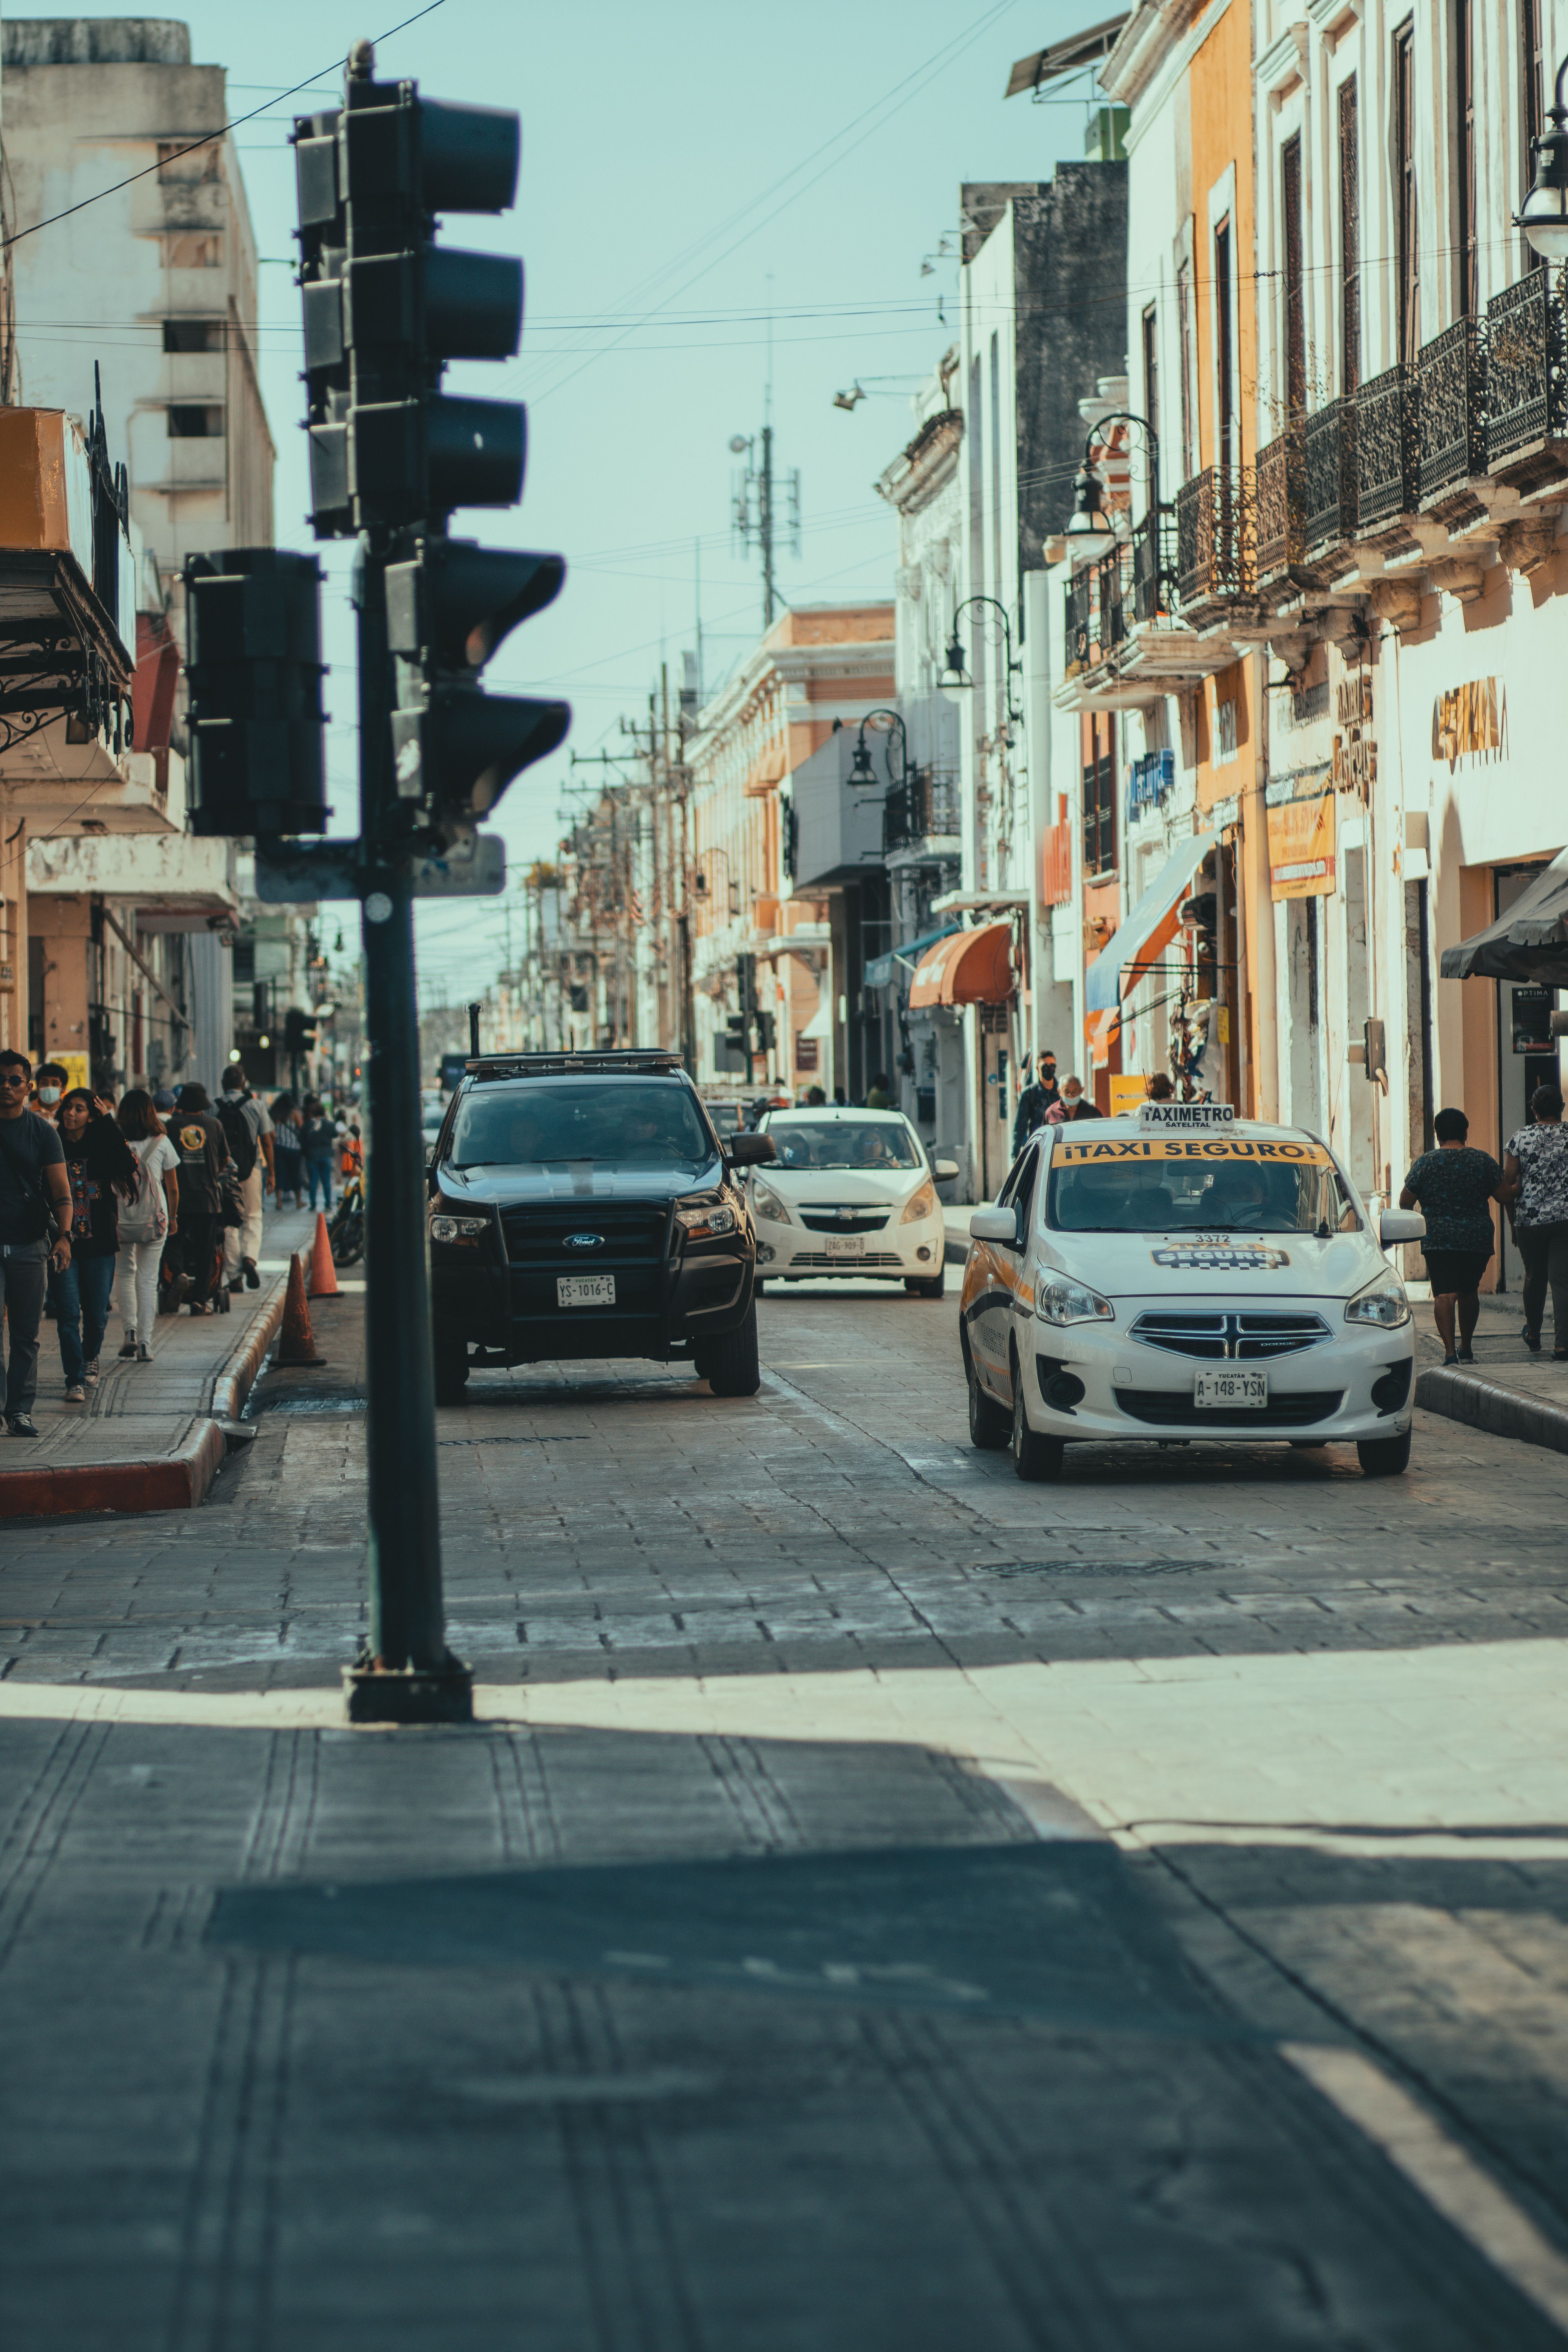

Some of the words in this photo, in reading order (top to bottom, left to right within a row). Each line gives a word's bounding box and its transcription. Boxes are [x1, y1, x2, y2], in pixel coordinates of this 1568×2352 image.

[1165, 1142, 1318, 1159] SEGURO!
[572, 1236, 595, 1246] Ford
[1158, 1252, 1283, 1261] SEGURO!
[560, 1283, 613, 1298] YS-1016-C
[1198, 1380, 1265, 1396] A-148-YSN
